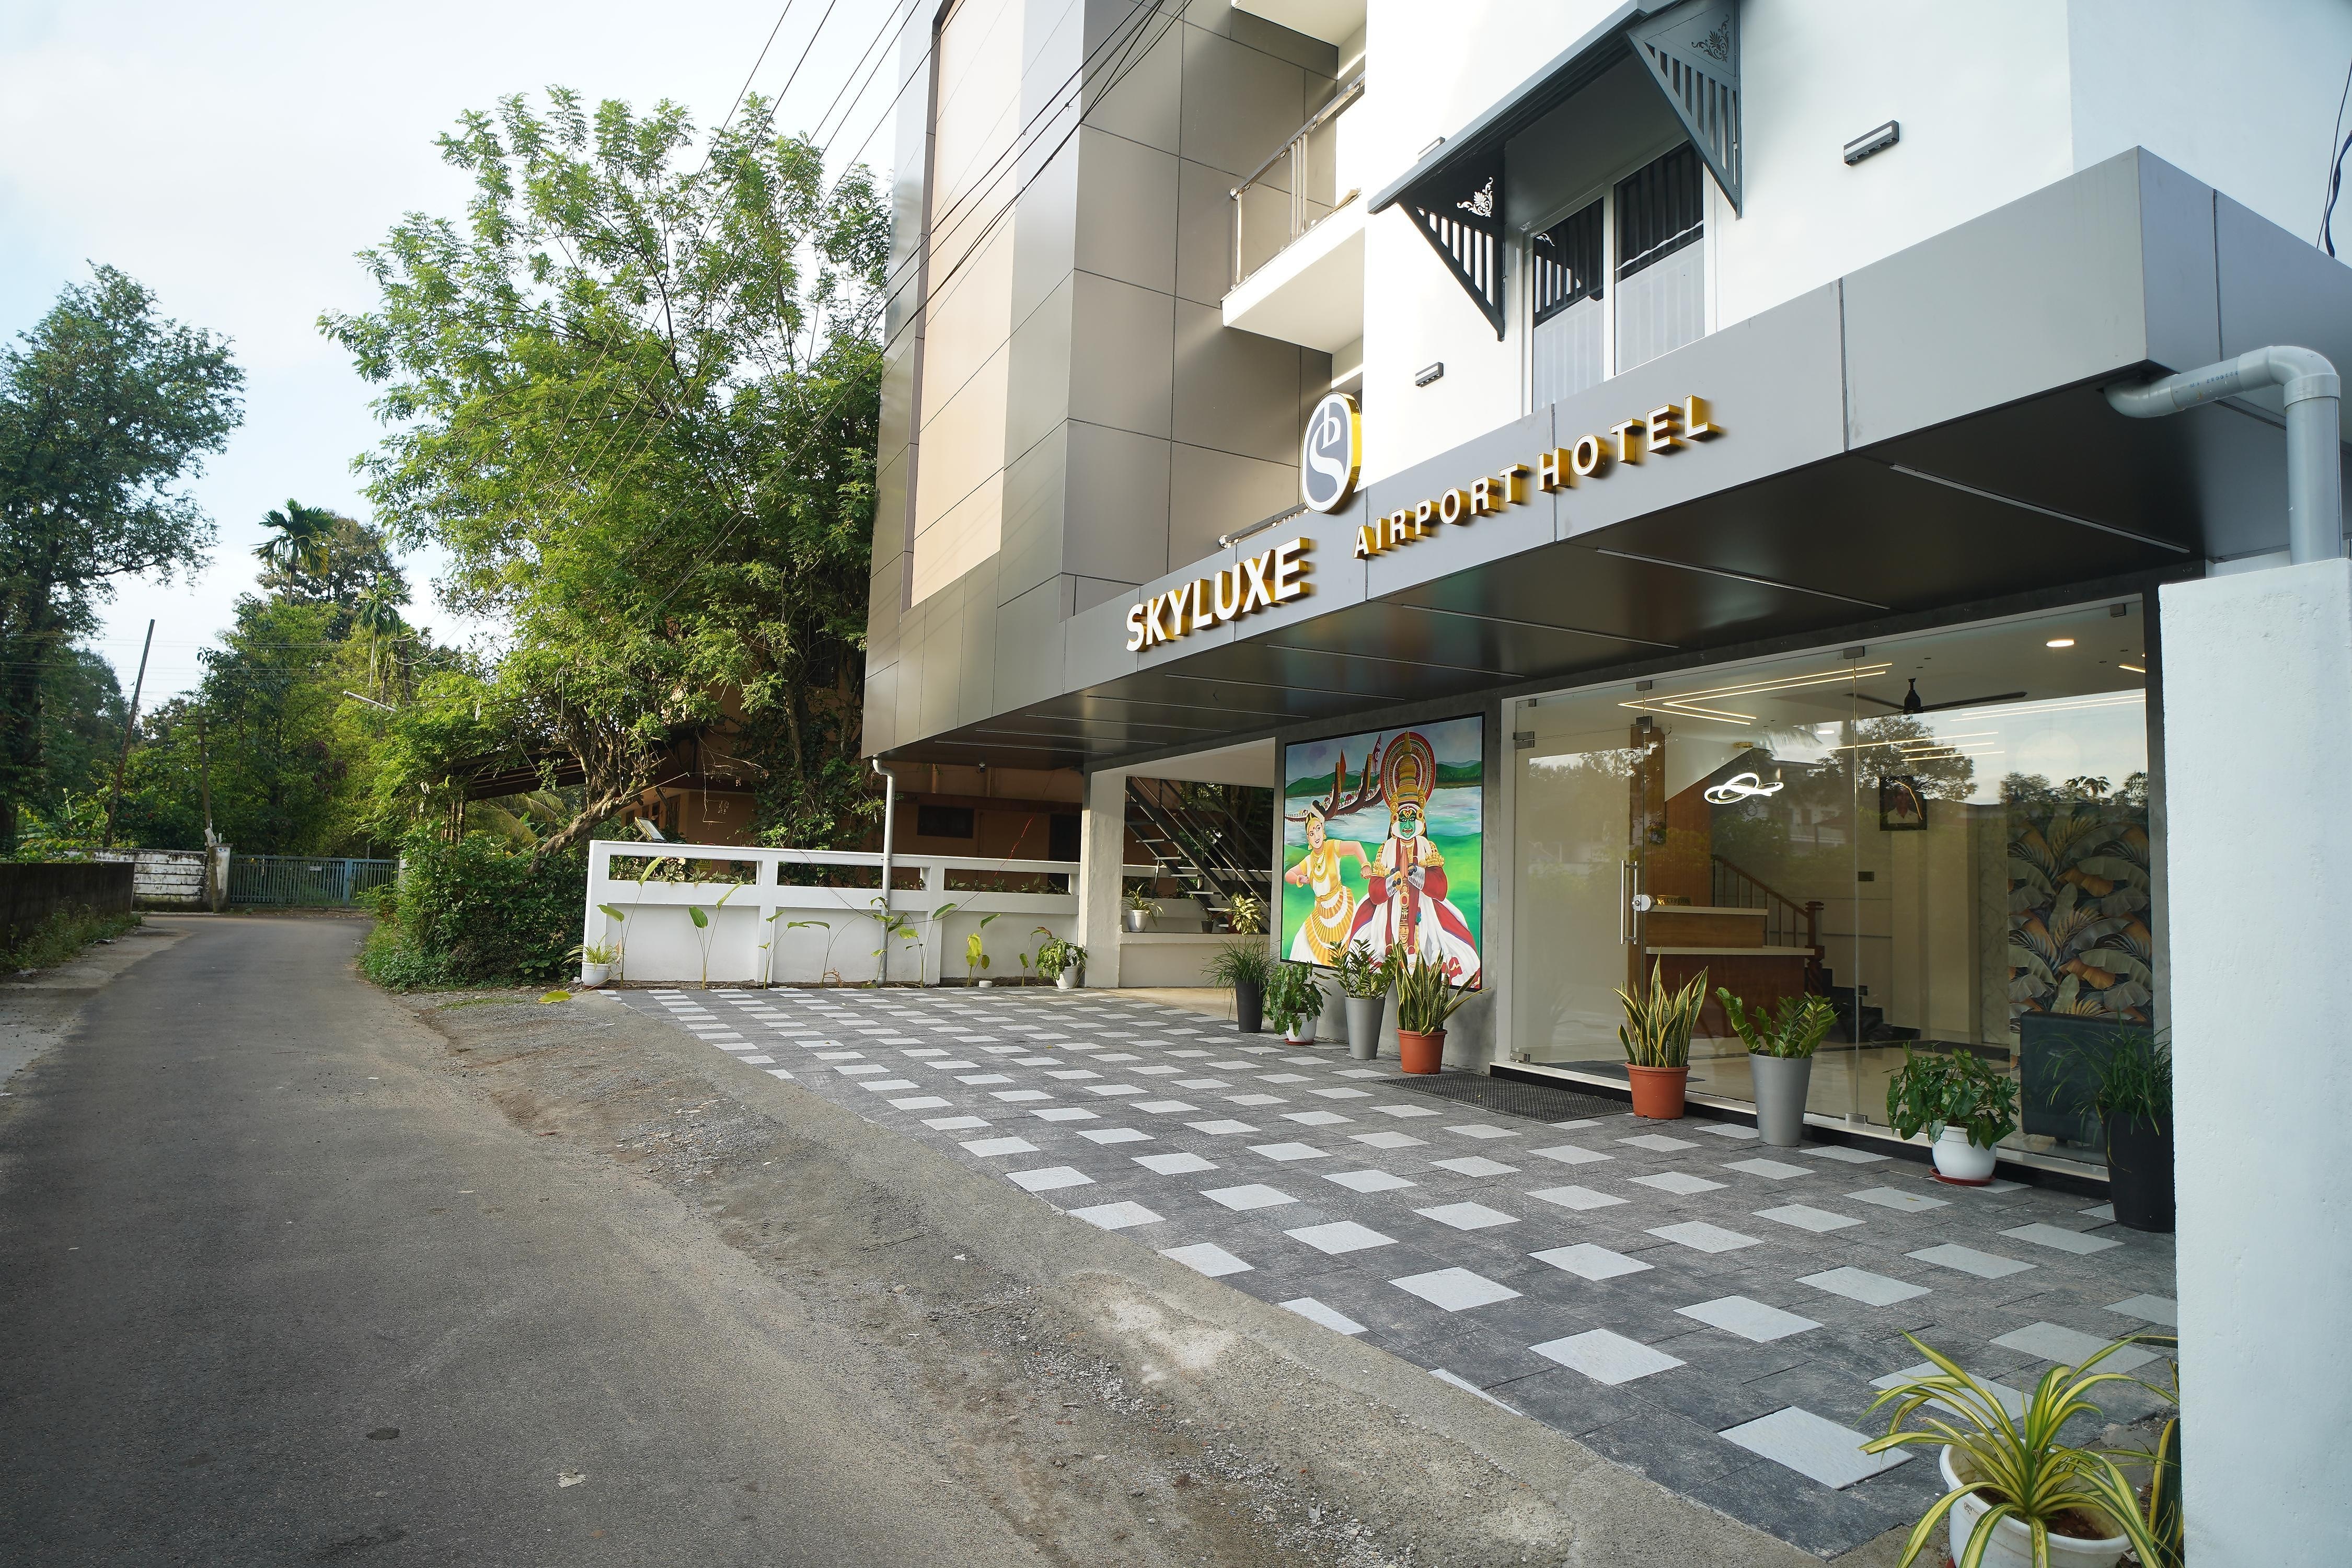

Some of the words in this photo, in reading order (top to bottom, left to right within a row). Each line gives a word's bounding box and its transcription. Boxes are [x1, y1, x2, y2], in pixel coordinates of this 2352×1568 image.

[1353, 463, 1528, 560] AIRPORT
[1537, 394, 1719, 493] HOTEL
[1126, 537, 1309, 652] SKYLUXE
